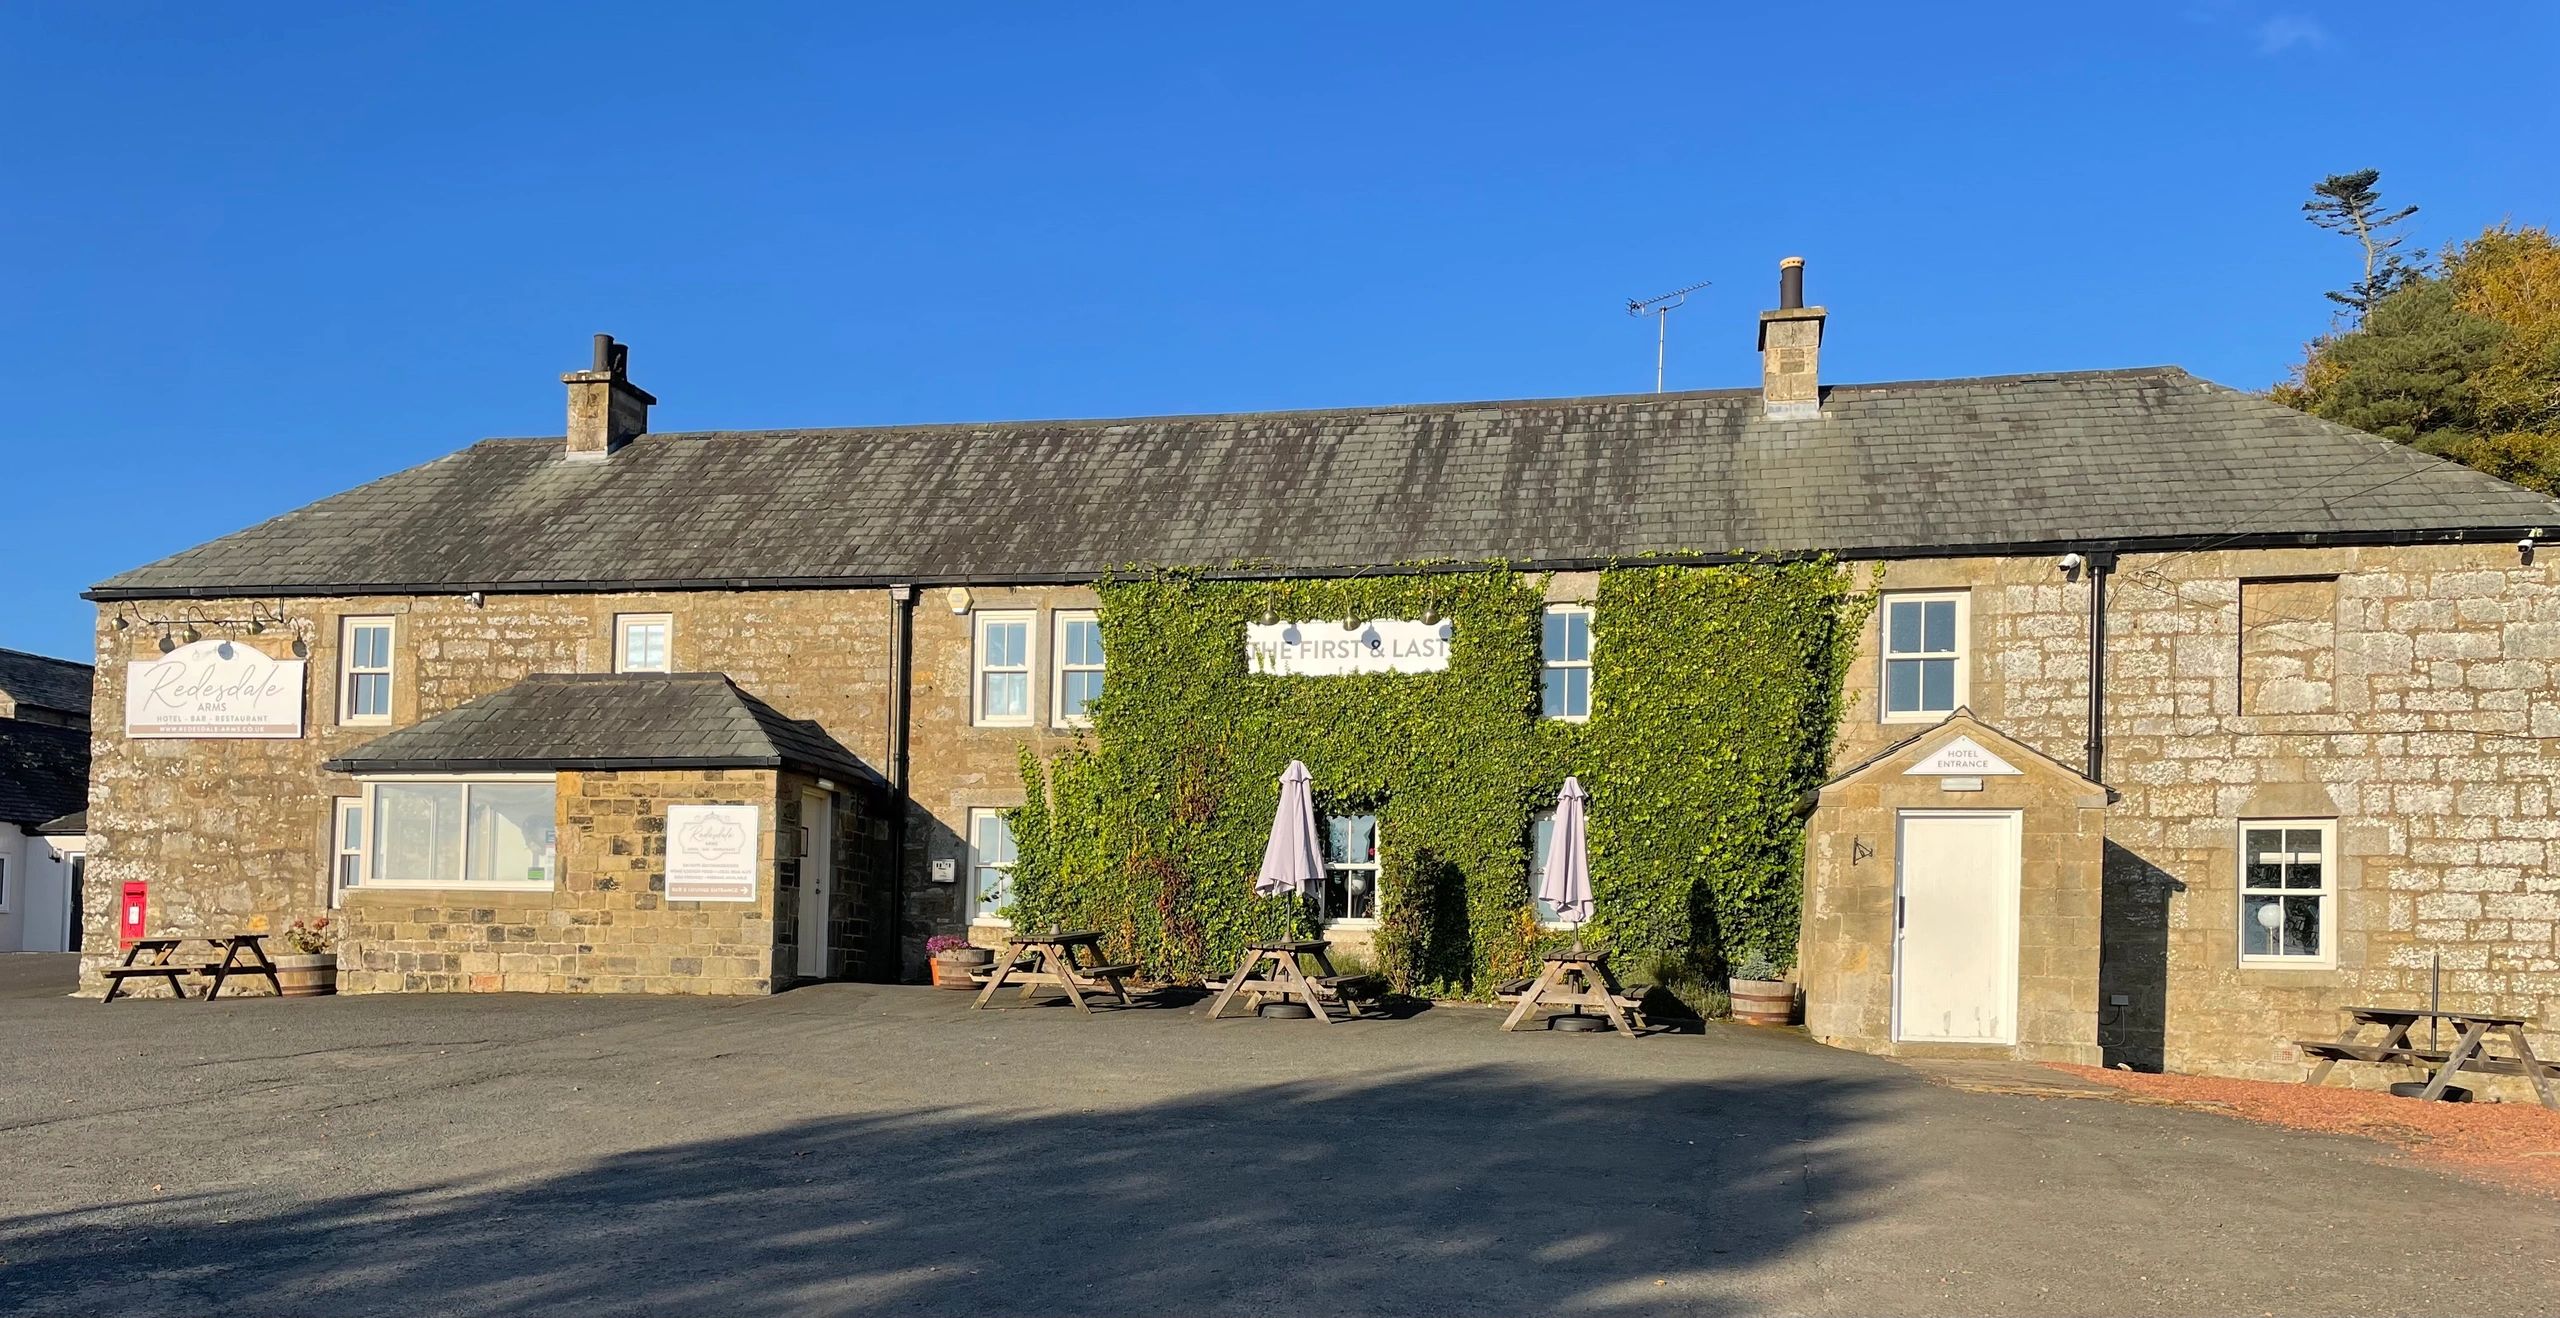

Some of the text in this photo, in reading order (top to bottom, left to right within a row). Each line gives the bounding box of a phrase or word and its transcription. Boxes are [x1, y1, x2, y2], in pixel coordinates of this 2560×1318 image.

[1249, 638, 1448, 659] THE FIRST & LAST
[142, 660, 285, 711] Redesdale
[197, 702, 227, 712] ARMS
[1947, 750, 1978, 758] HOTEL
[1937, 760, 1988, 768] ENTRANCE
